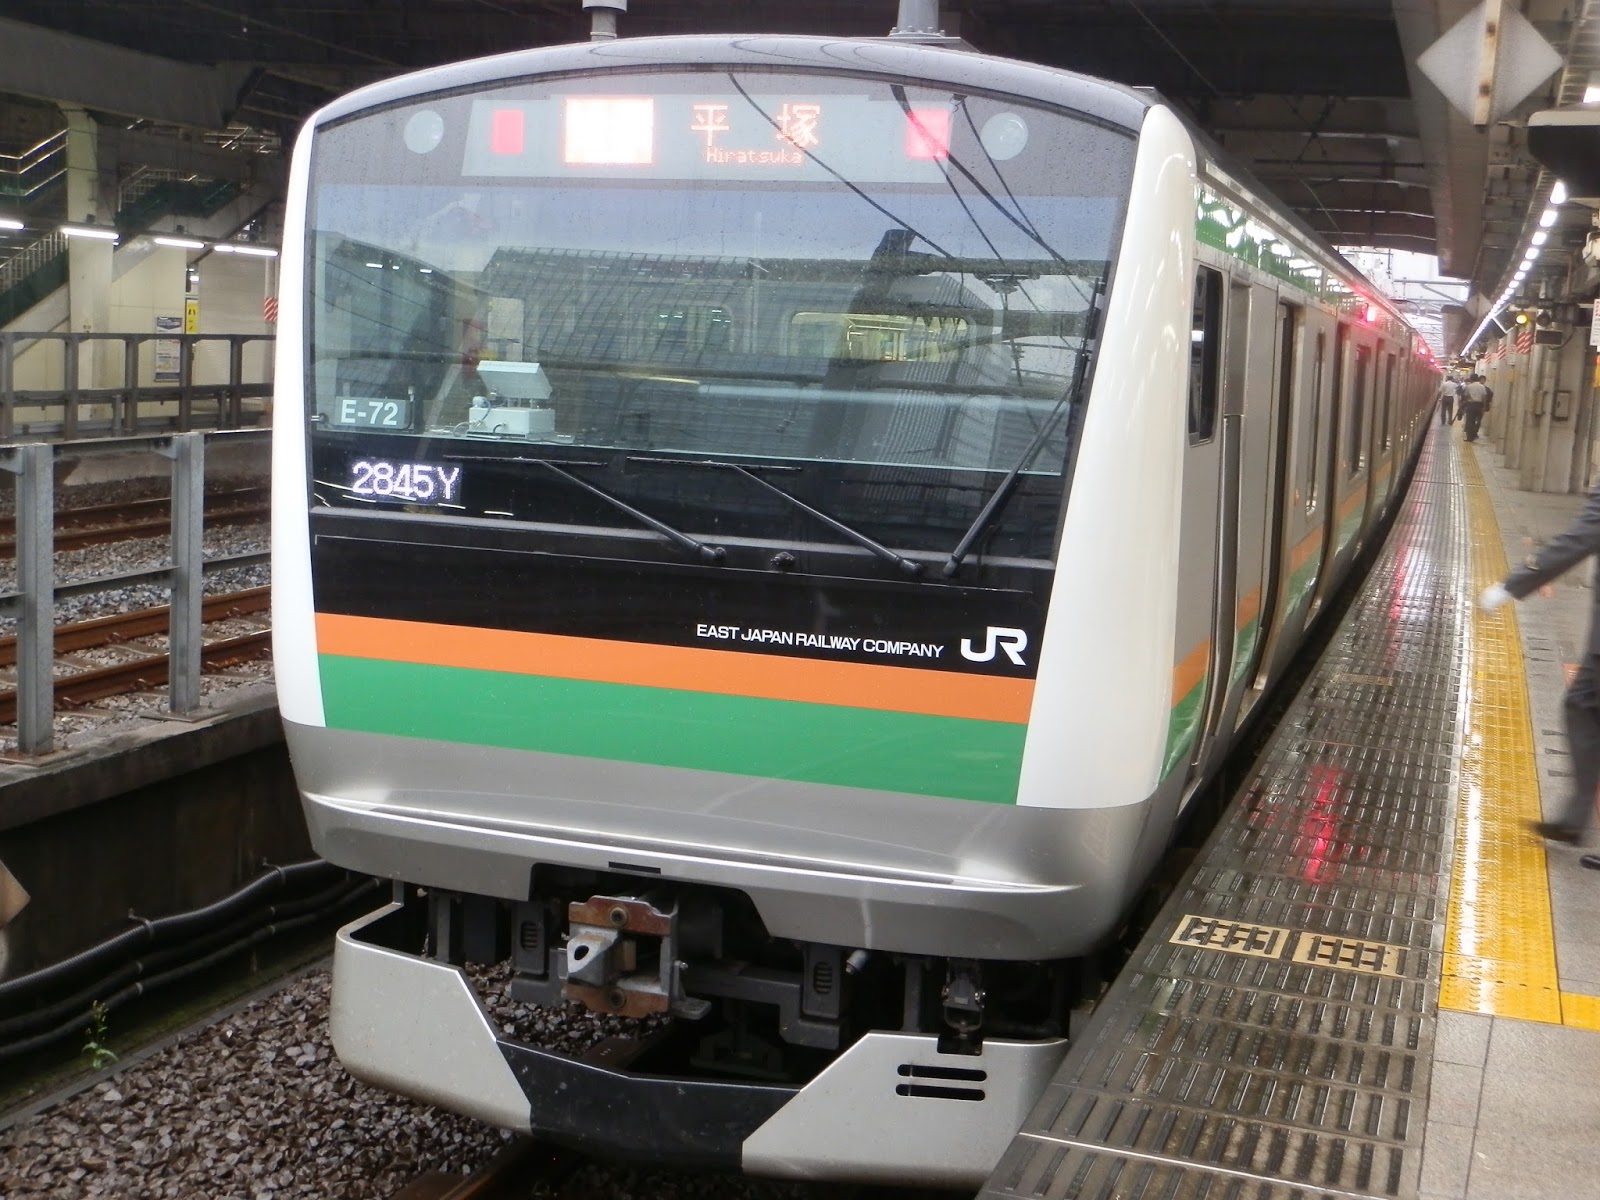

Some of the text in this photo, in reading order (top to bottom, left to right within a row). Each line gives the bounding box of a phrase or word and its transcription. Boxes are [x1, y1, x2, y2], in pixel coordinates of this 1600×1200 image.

[691, 102, 820, 147] 平塚
[706, 147, 803, 164] Hiratsuka
[340, 400, 399, 426] E-72
[352, 461, 460, 500] 2845Y
[696, 624, 944, 658] EAST JAPAN RAILWAY COMPANY
[960, 626, 1028, 666] JR
